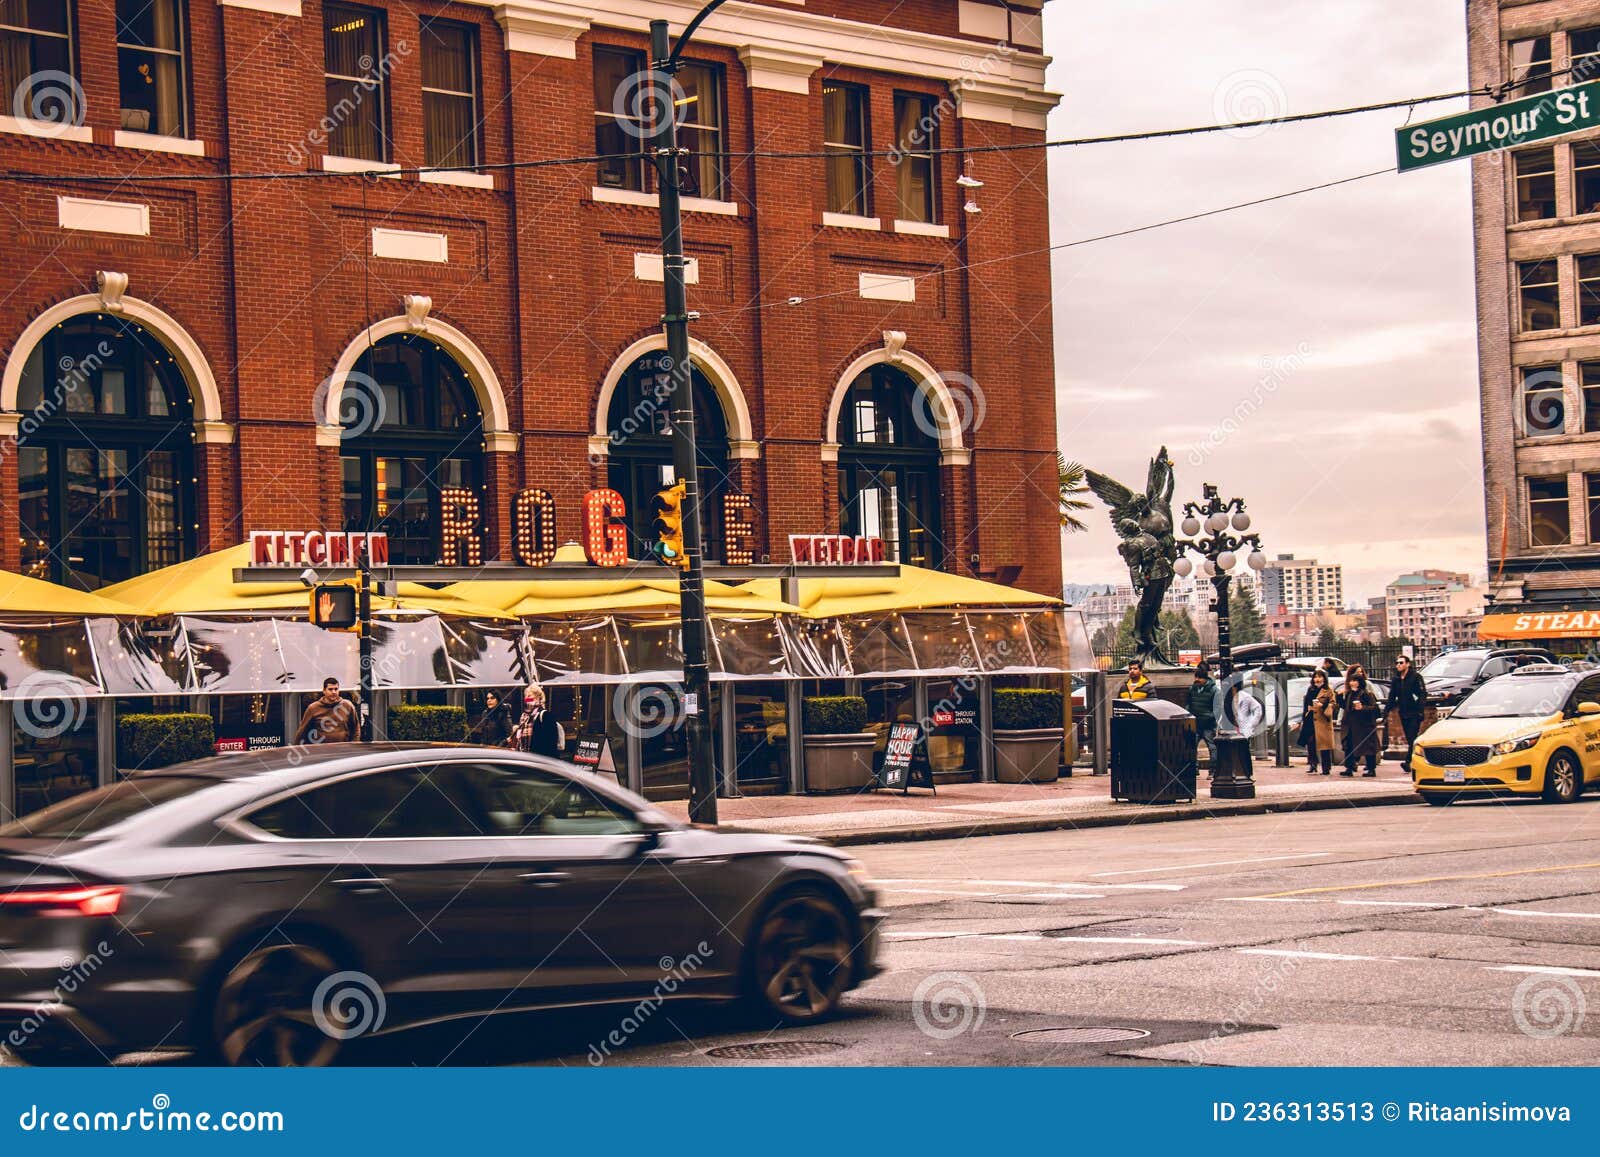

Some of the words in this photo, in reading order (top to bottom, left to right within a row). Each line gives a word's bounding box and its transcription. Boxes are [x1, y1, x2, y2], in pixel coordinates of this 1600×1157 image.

[1410, 108, 1541, 158] Seymour
[1556, 91, 1590, 124] St
[250, 531, 388, 567] KITCHEN
[789, 535, 886, 565] WETBAR
[249, 736, 280, 744] THROUGH
[891, 726, 919, 740] HAPPY
[220, 742, 244, 751] ENTER
[887, 740, 913, 755] HOUR
